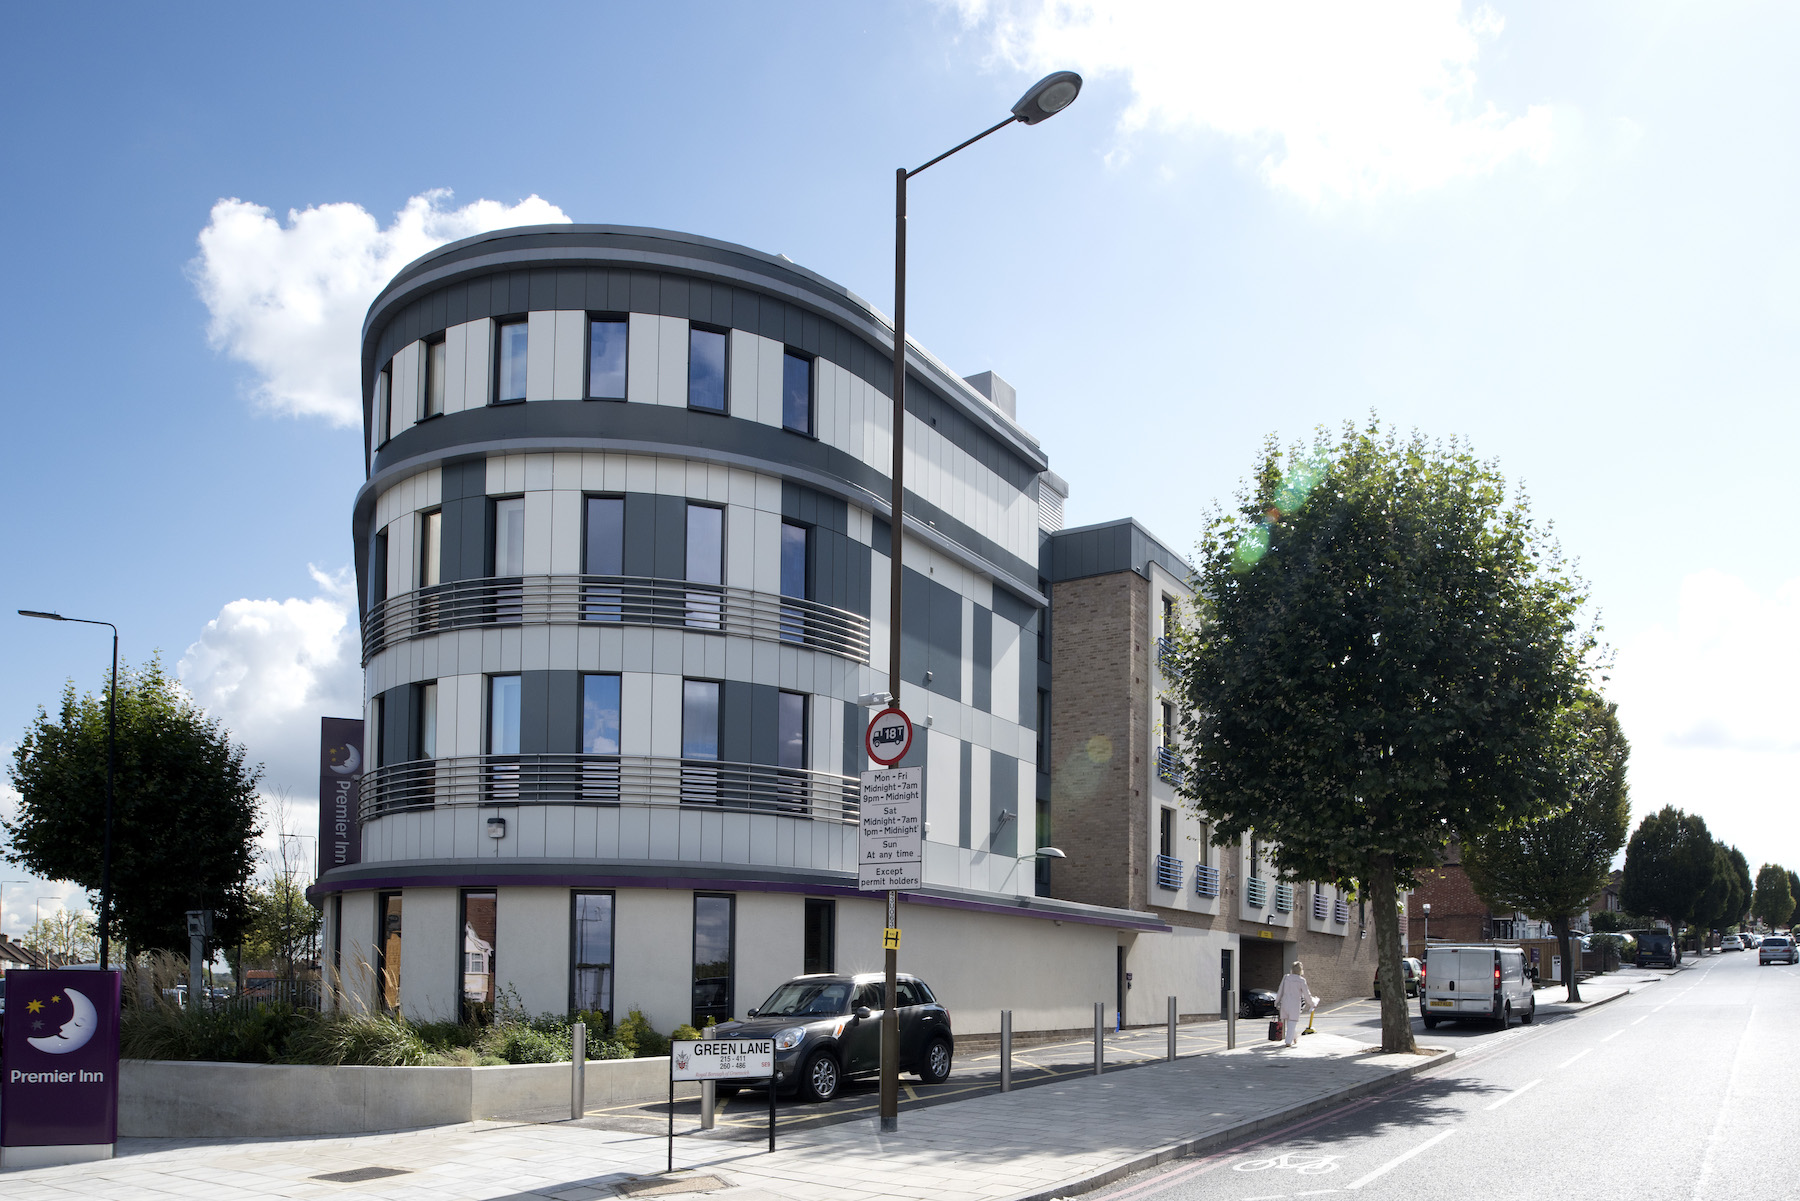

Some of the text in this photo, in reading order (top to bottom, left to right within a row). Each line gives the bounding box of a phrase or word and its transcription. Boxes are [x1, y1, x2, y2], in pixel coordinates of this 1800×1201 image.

[874, 774, 890, 782] Mon
[897, 771, 908, 780] Fri
[864, 782, 896, 792] Midnight
[901, 781, 918, 789] 7am
[863, 794, 880, 803] 9pm
[885, 792, 919, 801] Midnight
[883, 806, 897, 815] Sat
[334, 780, 351, 864] Premier Inn
[863, 817, 896, 826] Midnight
[901, 815, 918, 824] 7am
[864, 828, 879, 837] 1pm
[884, 826, 918, 835] Midnight
[882, 840, 898, 849] Sun
[866, 850, 914, 860] At any time
[876, 868, 903, 876] Except
[861, 877, 919, 887] permit holders
[884, 930, 899, 947] H
[694, 1042, 770, 1056] GREEN LANE
[720, 1055, 731, 1063] 215
[720, 1062, 731, 1070] 260
[10, 1069, 104, 1083] Premier Inn
